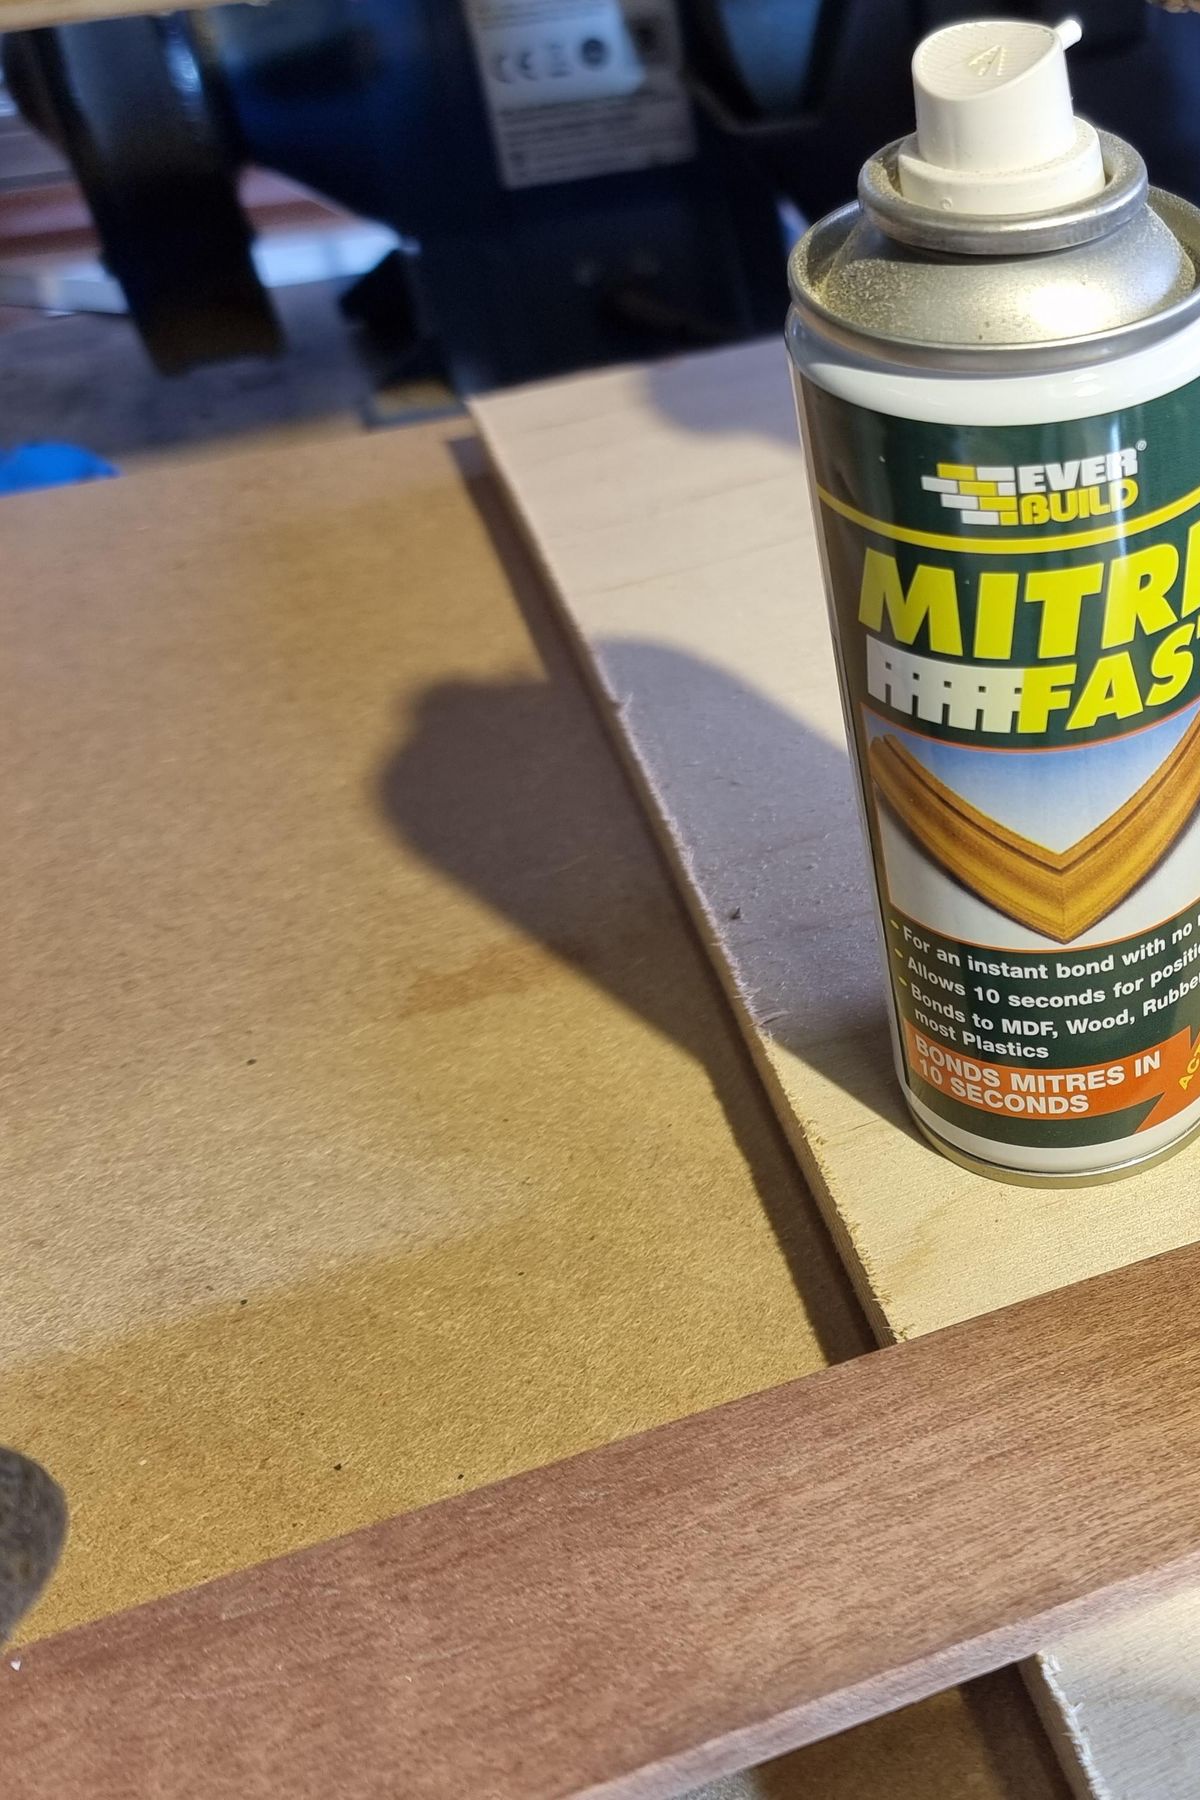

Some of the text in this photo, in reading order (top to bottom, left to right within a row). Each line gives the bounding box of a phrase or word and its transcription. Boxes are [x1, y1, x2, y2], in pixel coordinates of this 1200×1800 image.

[1018, 447, 1139, 494] EVER
[1018, 478, 1140, 526] BUILD
[903, 926, 931, 953] For
[936, 948, 961, 967] an
[967, 955, 1048, 979] instant
[1056, 954, 1115, 979] bond
[1121, 938, 1166, 966] with
[1172, 922, 1193, 944] no
[907, 956, 966, 997] Allows
[974, 986, 1000, 1004] 10
[1008, 988, 1106, 1008] seconds
[1113, 976, 1145, 998] for
[911, 982, 966, 1024] Bonds
[972, 1013, 994, 1031] to
[1001, 1018, 1058, 1039] MDF,
[1066, 1008, 1136, 1035] Wood,
[914, 1008, 1050, 1058] most Plastics
[915, 1034, 1162, 1094] BONDS MITRES IN
[919, 1058, 1090, 1115] 10 SECONDS
